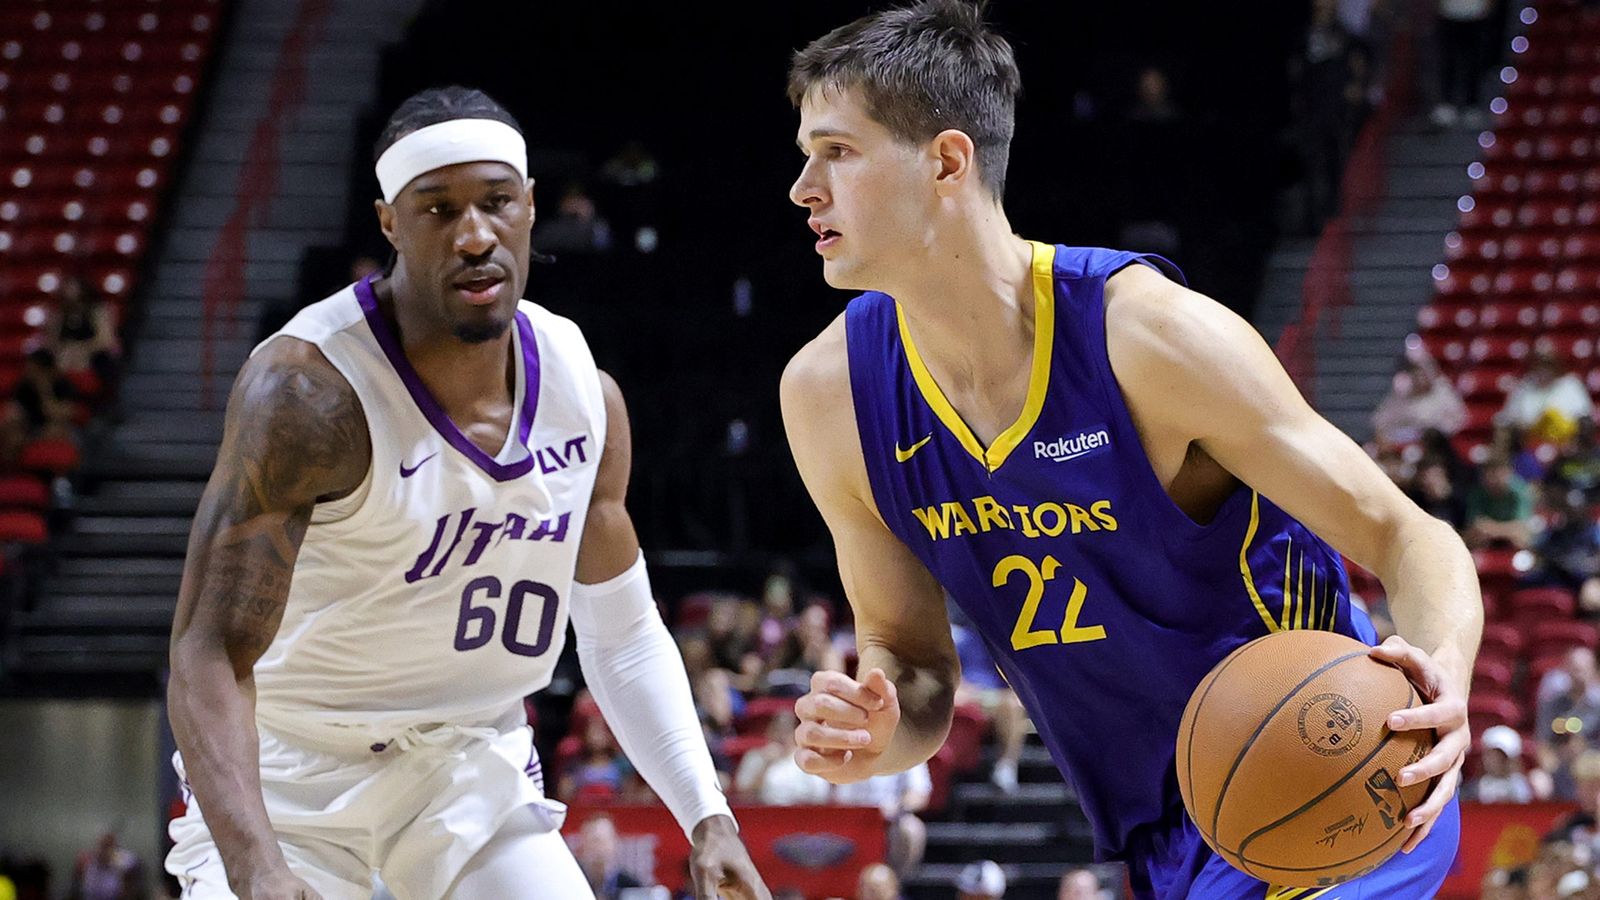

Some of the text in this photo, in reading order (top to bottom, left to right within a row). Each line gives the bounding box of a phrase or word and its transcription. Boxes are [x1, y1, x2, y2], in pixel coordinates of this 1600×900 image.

[1034, 430, 1110, 459] Rakuten
[404, 507, 572, 584] UTAH
[911, 495, 1118, 541] WARIORS
[453, 575, 560, 658] 60
[992, 554, 1107, 651] 22
